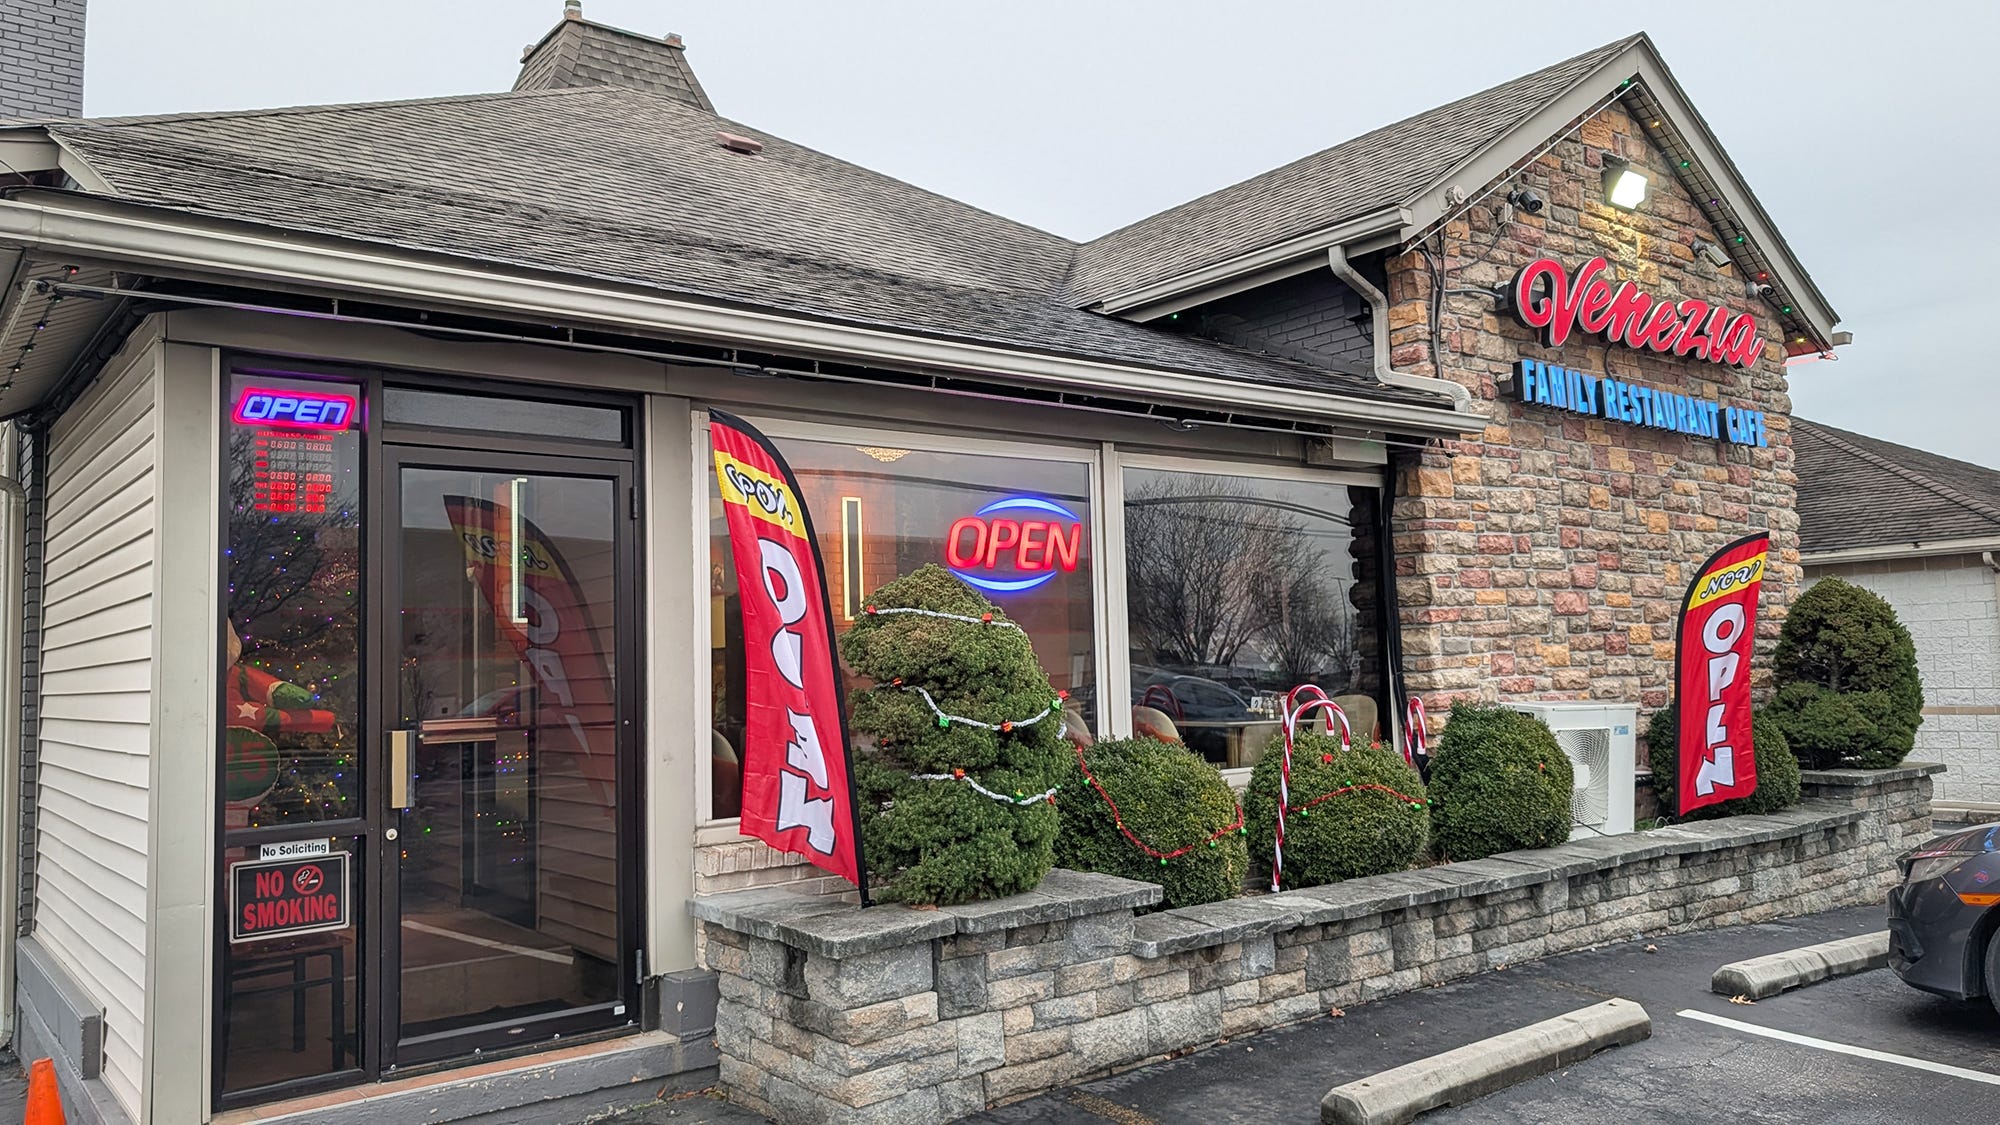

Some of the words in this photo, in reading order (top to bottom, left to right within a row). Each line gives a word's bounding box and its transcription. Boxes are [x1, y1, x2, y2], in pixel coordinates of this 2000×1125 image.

[1516, 256, 1765, 368] Venezia
[243, 396, 348, 424] OPEN
[1521, 359, 1598, 415] FAMILY
[1602, 378, 1719, 439] RESTAURANT
[1726, 407, 1767, 448] CAFE
[946, 516, 1081, 572] OPEN
[1700, 559, 1761, 600] NOW
[1696, 602, 1746, 798] OPEN
[262, 847, 276, 857] No
[279, 842, 327, 856] Soliciting
[256, 870, 285, 899] NO
[243, 893, 337, 931] SMOKING
